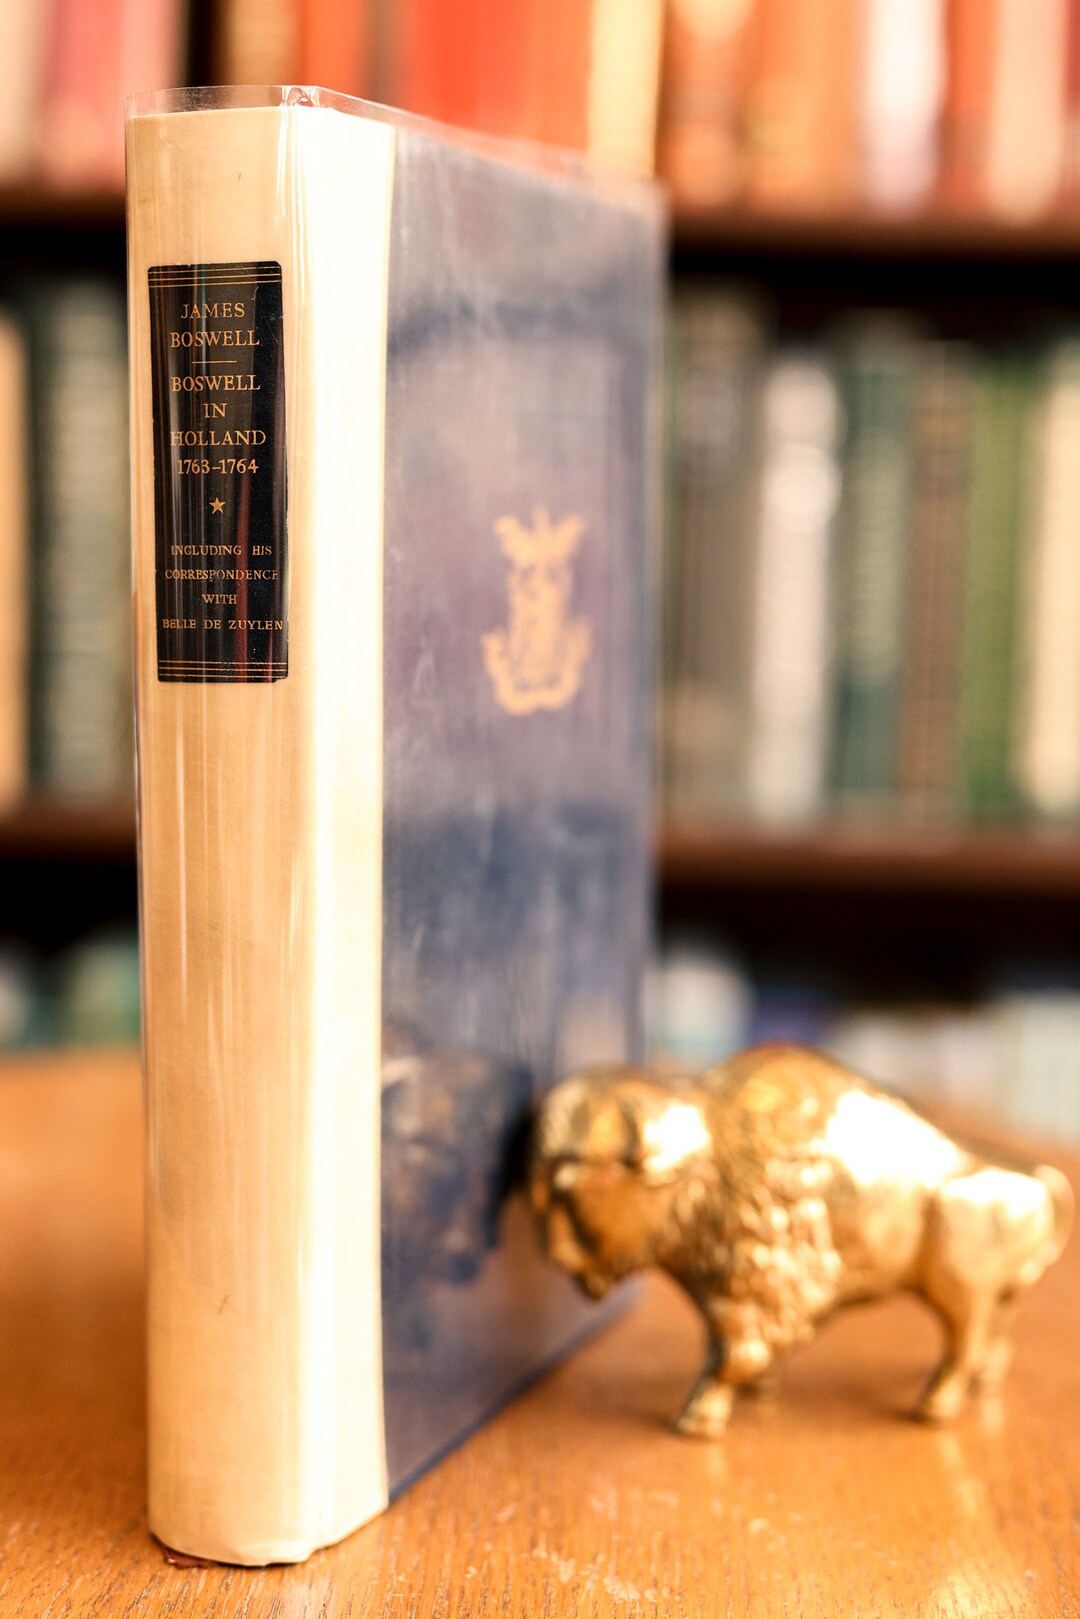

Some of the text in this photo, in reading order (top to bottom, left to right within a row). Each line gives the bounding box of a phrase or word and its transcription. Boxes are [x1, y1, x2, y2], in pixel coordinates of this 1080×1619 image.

[181, 302, 245, 319] JAMES
[170, 330, 260, 348] BOSWELL
[171, 375, 261, 392] BOSWELL
[203, 402, 227, 419] IN
[170, 430, 267, 446] HOLLAND
[171, 545, 272, 556] INCLUDING HIS
[164, 569, 279, 582] CORRESPONDENCE
[201, 594, 238, 605] WITH
[162, 619, 284, 630] BELLE DE ZUYLEN
